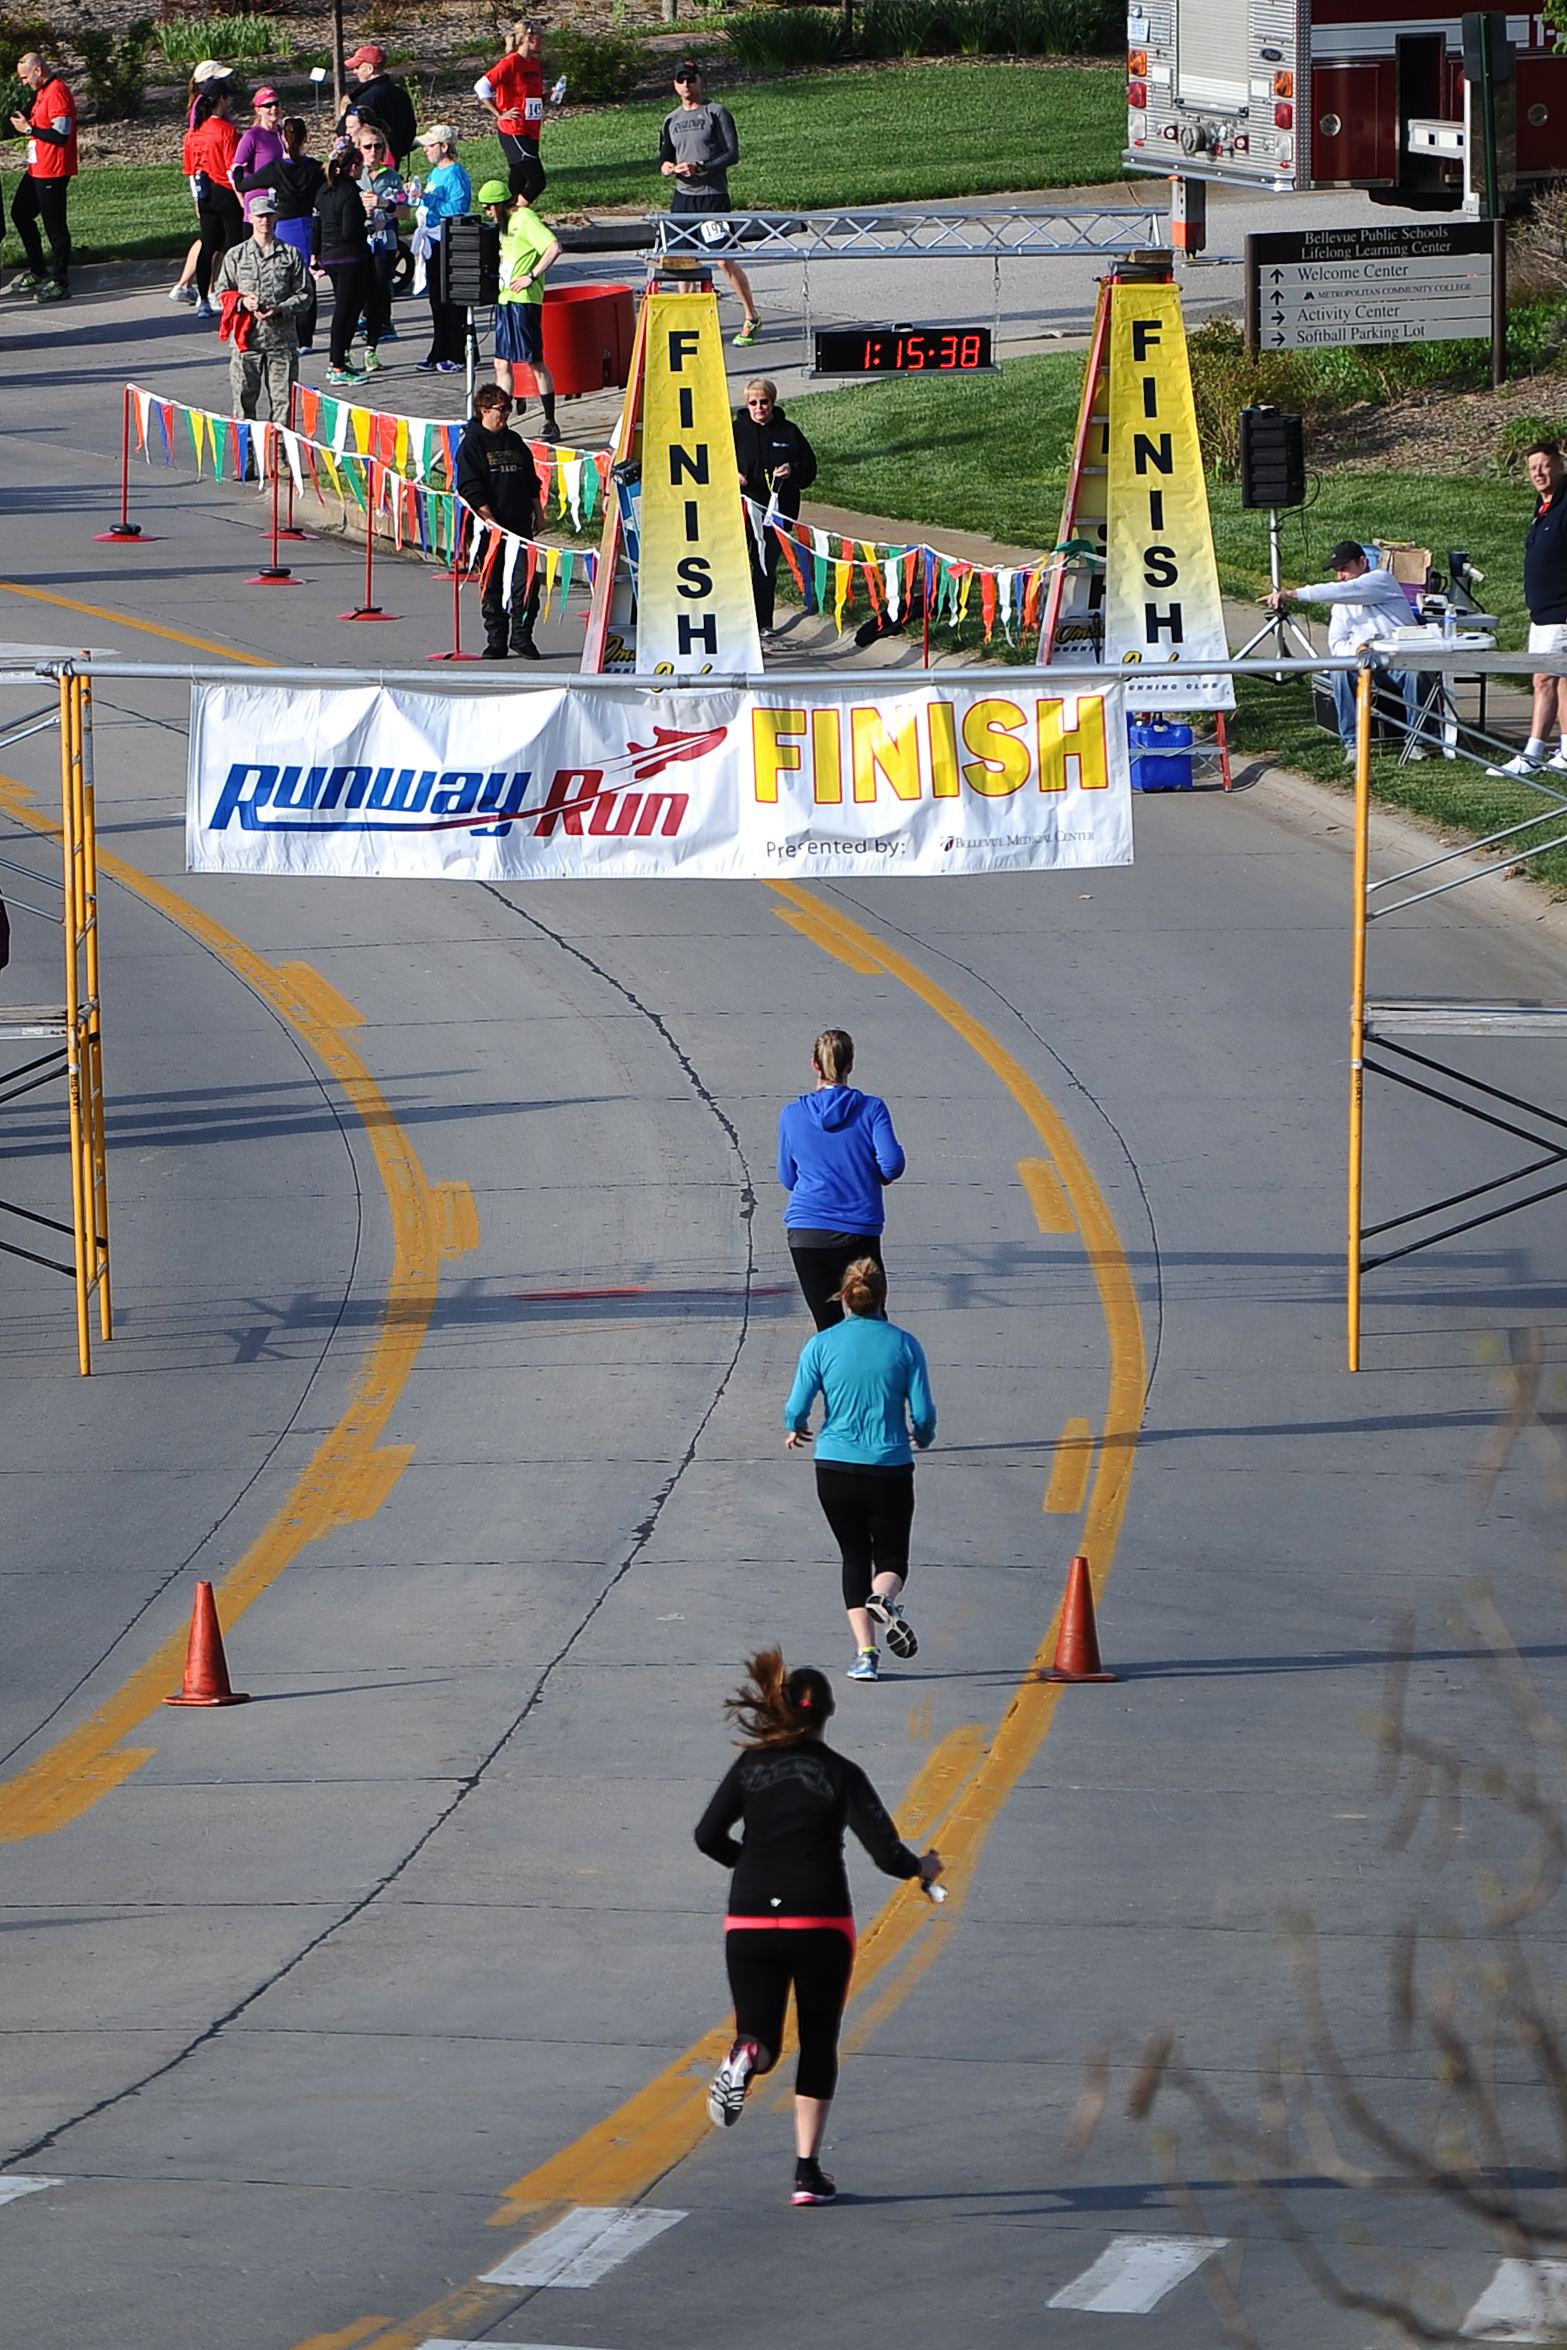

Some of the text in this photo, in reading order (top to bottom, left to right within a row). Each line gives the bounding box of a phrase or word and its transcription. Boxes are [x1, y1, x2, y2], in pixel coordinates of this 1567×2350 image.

[1305, 225, 1449, 245] Bellevue Public Schools
[1301, 241, 1452, 260] Lifelong Learning Center
[1297, 263, 1409, 281] Welcome Center
[1318, 282, 1471, 298] METROPOLITAN COMMUNITY COLLEGE
[1297, 304, 1400, 323] Activity Center
[1297, 324, 1425, 344] Softball Parking Lot
[1132, 320, 1184, 644] FINISH
[668, 330, 718, 656] FINISH
[1127, 682, 1218, 692] UNNING CLUB
[751, 694, 1109, 805] FINISH
[208, 763, 690, 838] Runway Run
[874, 838, 906, 858] by:
